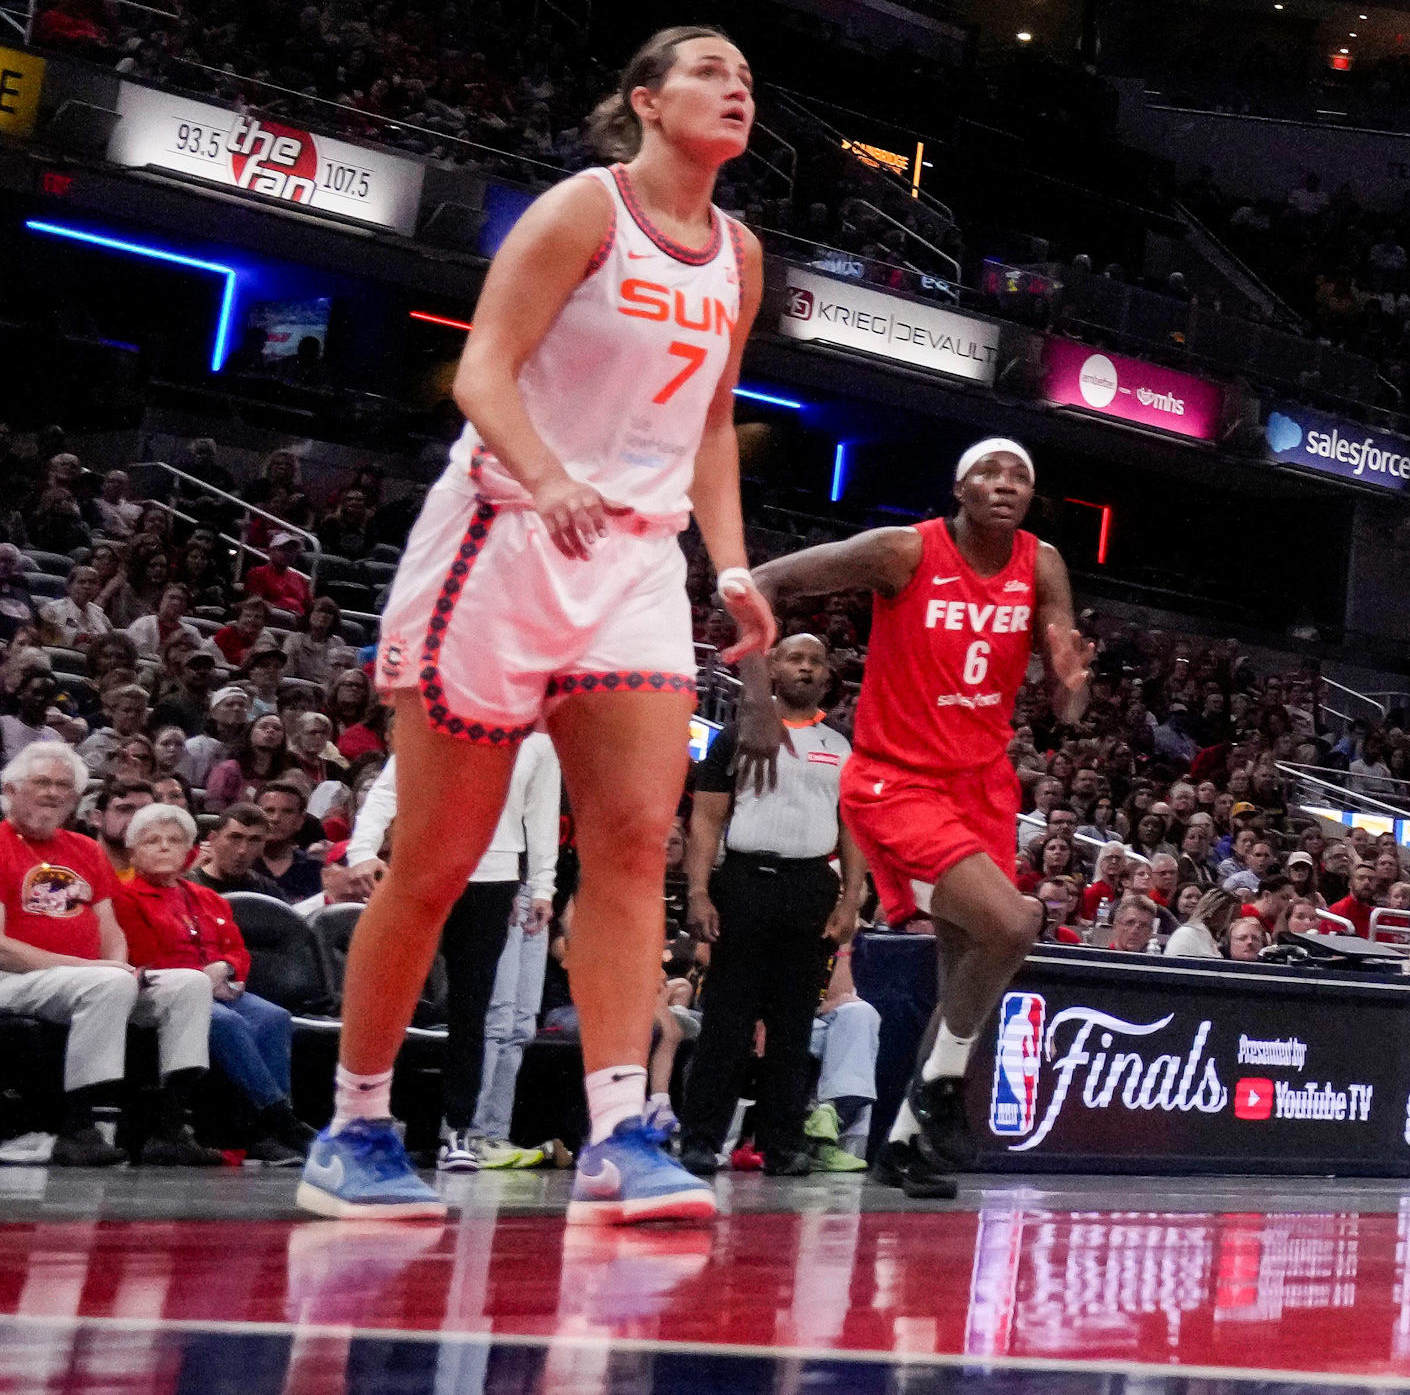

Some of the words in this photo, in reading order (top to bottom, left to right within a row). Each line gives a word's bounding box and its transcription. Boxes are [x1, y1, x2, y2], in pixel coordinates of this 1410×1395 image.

[176, 123, 220, 159] 93.5
[226, 116, 301, 164] the
[238, 156, 317, 206] fan
[323, 162, 370, 199] 107.5
[617, 278, 737, 336] SUN
[817, 302, 887, 335] KRIEG
[652, 340, 708, 404] 7
[1153, 391, 1185, 415] mhs
[925, 599, 1031, 634] FEVER
[963, 640, 991, 685] 6
[1238, 1034, 1290, 1066] Presented
[1290, 1037, 1307, 1072] by
[1008, 1006, 1228, 1151] Finals
[1275, 1081, 1347, 1120] YouTube
[1348, 1084, 1374, 1121] TV
